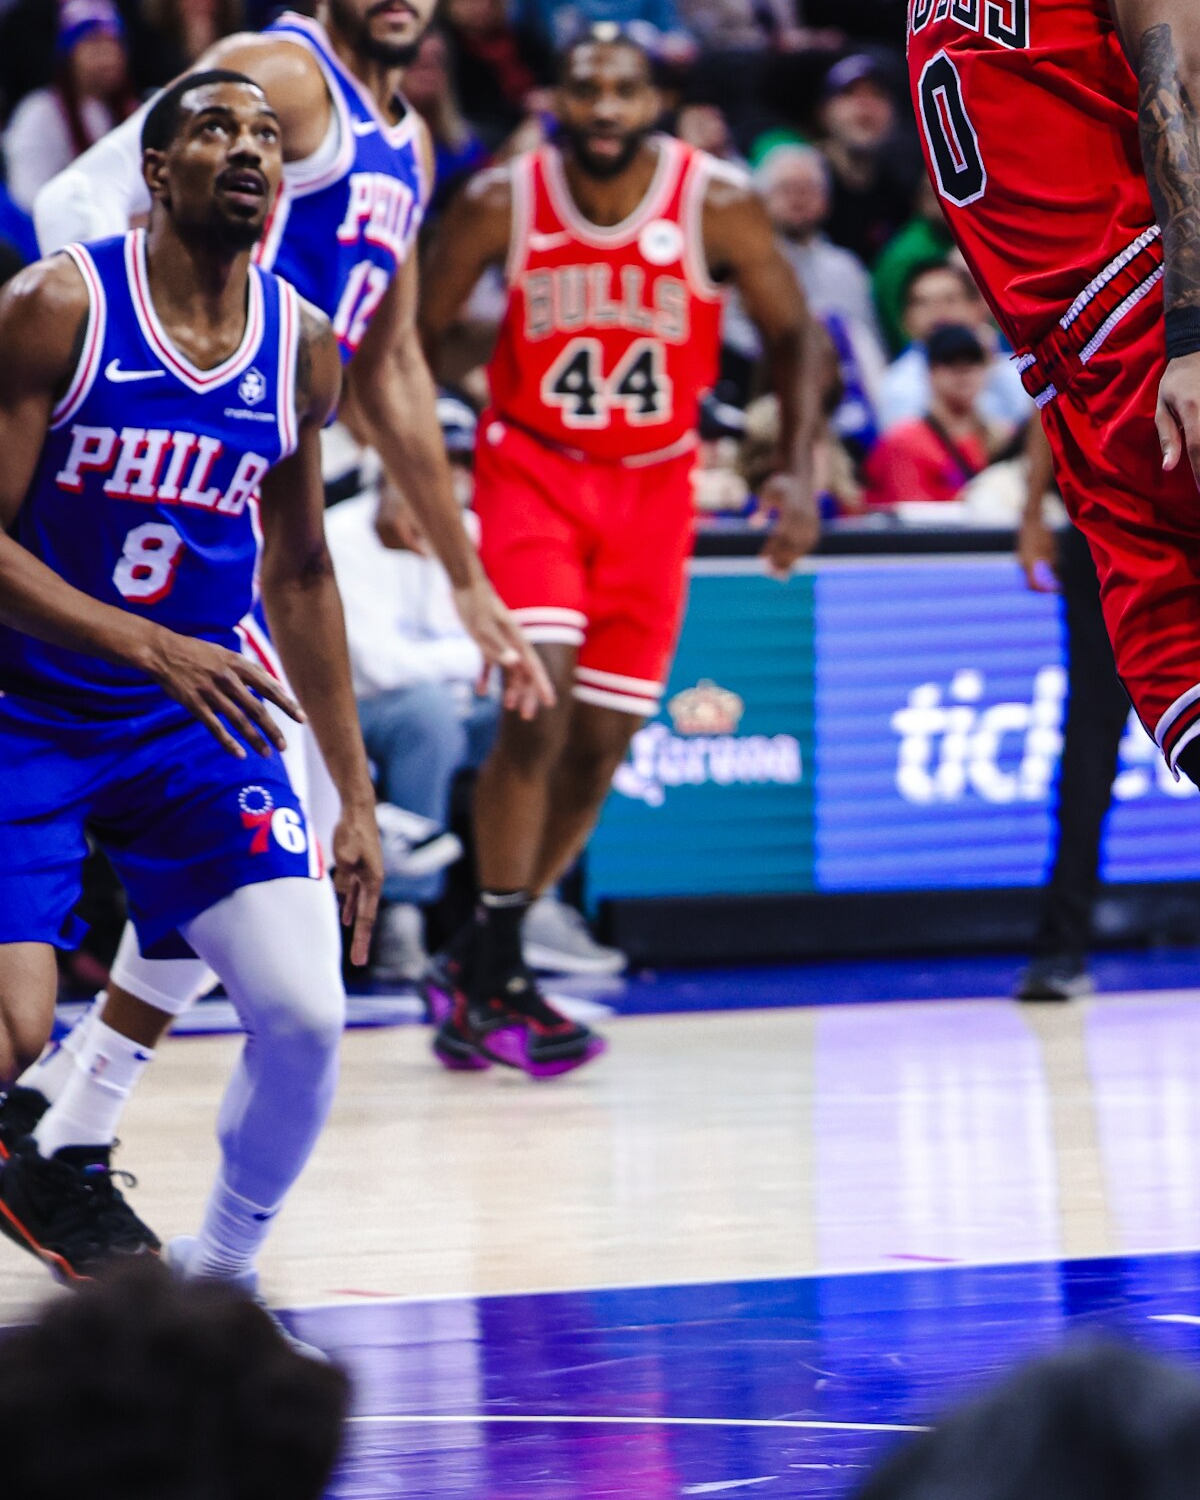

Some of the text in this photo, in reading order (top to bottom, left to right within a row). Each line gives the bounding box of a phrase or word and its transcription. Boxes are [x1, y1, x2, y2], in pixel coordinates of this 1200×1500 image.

[918, 49, 987, 207] 0
[336, 171, 424, 265] PHIL
[523, 264, 692, 346] BULLS
[540, 336, 673, 429] 44
[112, 522, 185, 605] 8
[239, 806, 308, 855] 76
